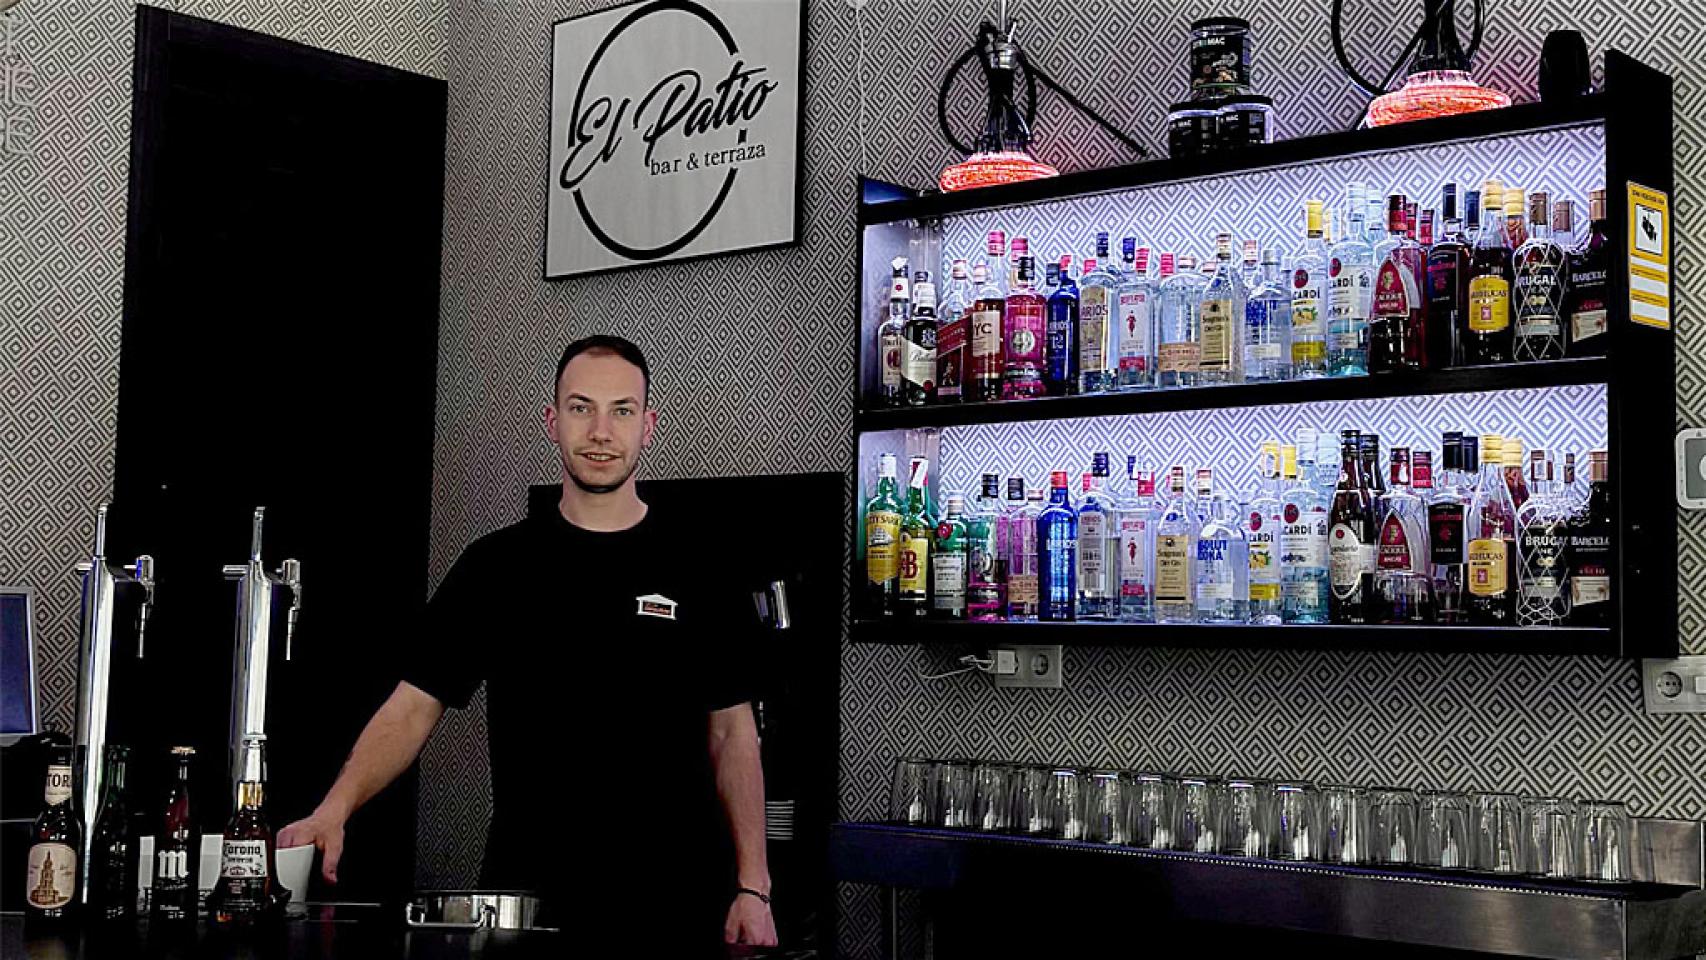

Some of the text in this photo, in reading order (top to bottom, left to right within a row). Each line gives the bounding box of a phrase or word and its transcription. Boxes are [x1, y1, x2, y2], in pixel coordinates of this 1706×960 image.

[560, 60, 779, 189] El Patio
[650, 143, 767, 176] bar & terraza
